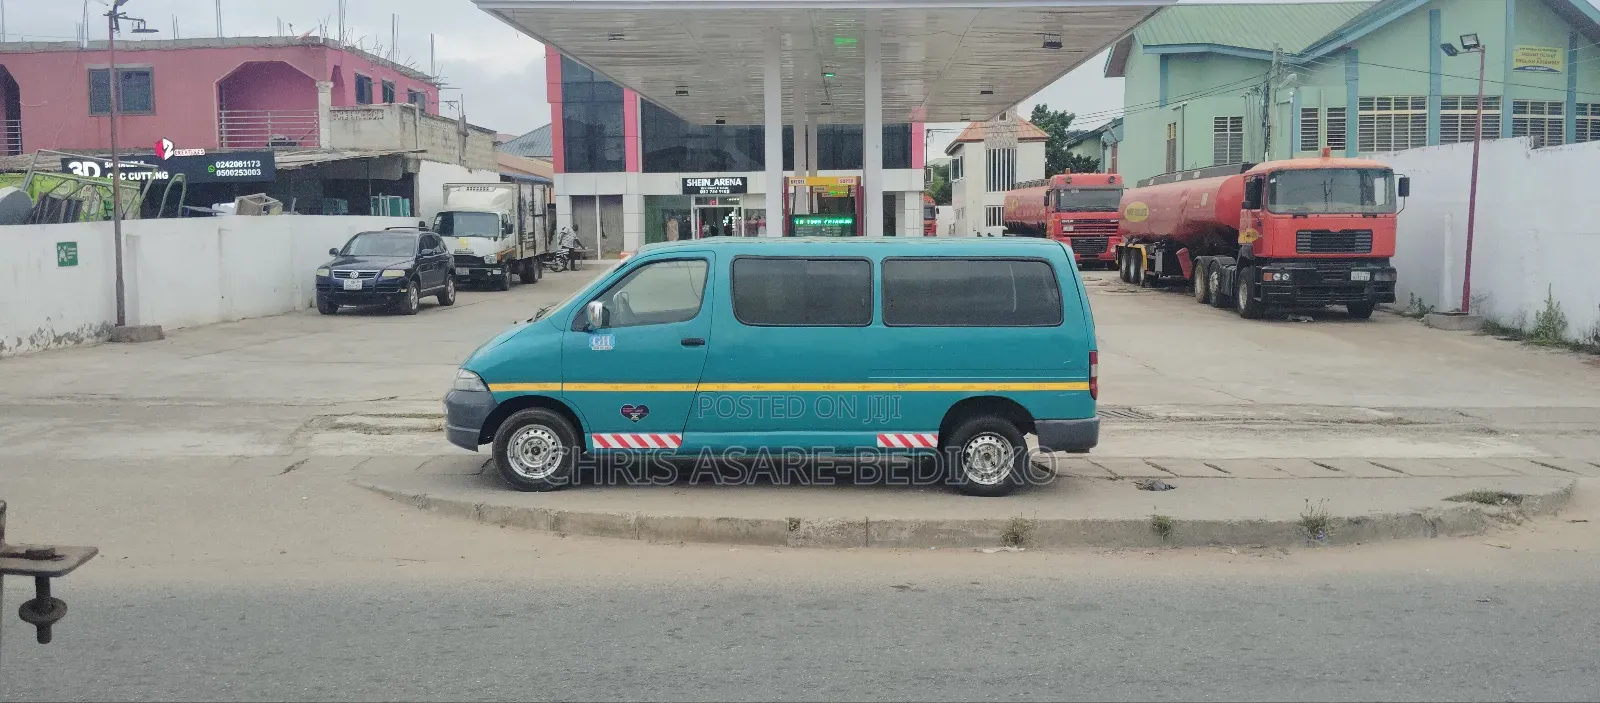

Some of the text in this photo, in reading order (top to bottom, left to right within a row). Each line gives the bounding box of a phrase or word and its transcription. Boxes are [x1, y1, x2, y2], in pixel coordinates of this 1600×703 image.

[215, 160, 261, 168] 0242061173
[68, 161, 101, 177] 3D
[216, 168, 261, 176] 0500253003
[128, 171, 169, 180] CUTTNG
